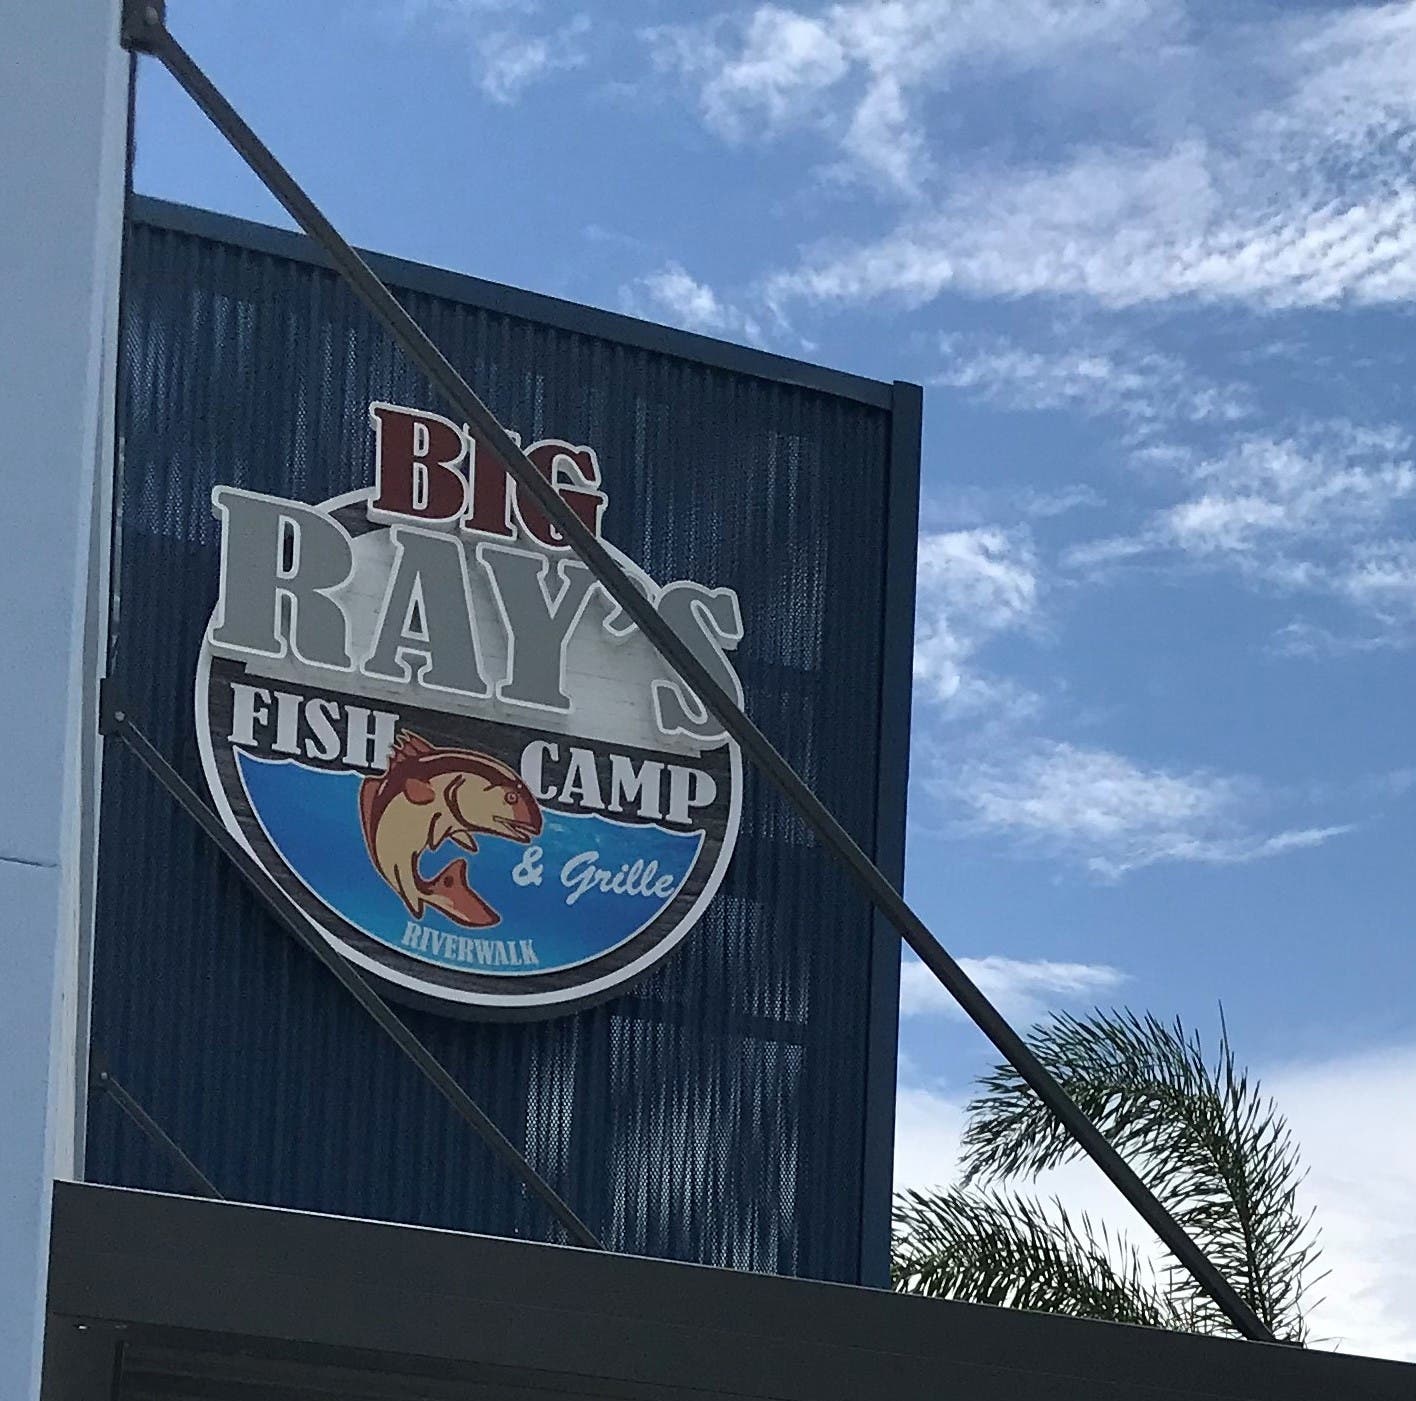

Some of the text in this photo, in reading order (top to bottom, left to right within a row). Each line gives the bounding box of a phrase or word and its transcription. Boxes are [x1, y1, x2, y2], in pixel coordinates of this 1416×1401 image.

[368, 402, 608, 550] BIG
[228, 682, 717, 824] FISH CAMP
[511, 846, 677, 906] & Grille
[401, 920, 540, 967] RIVERWALK
